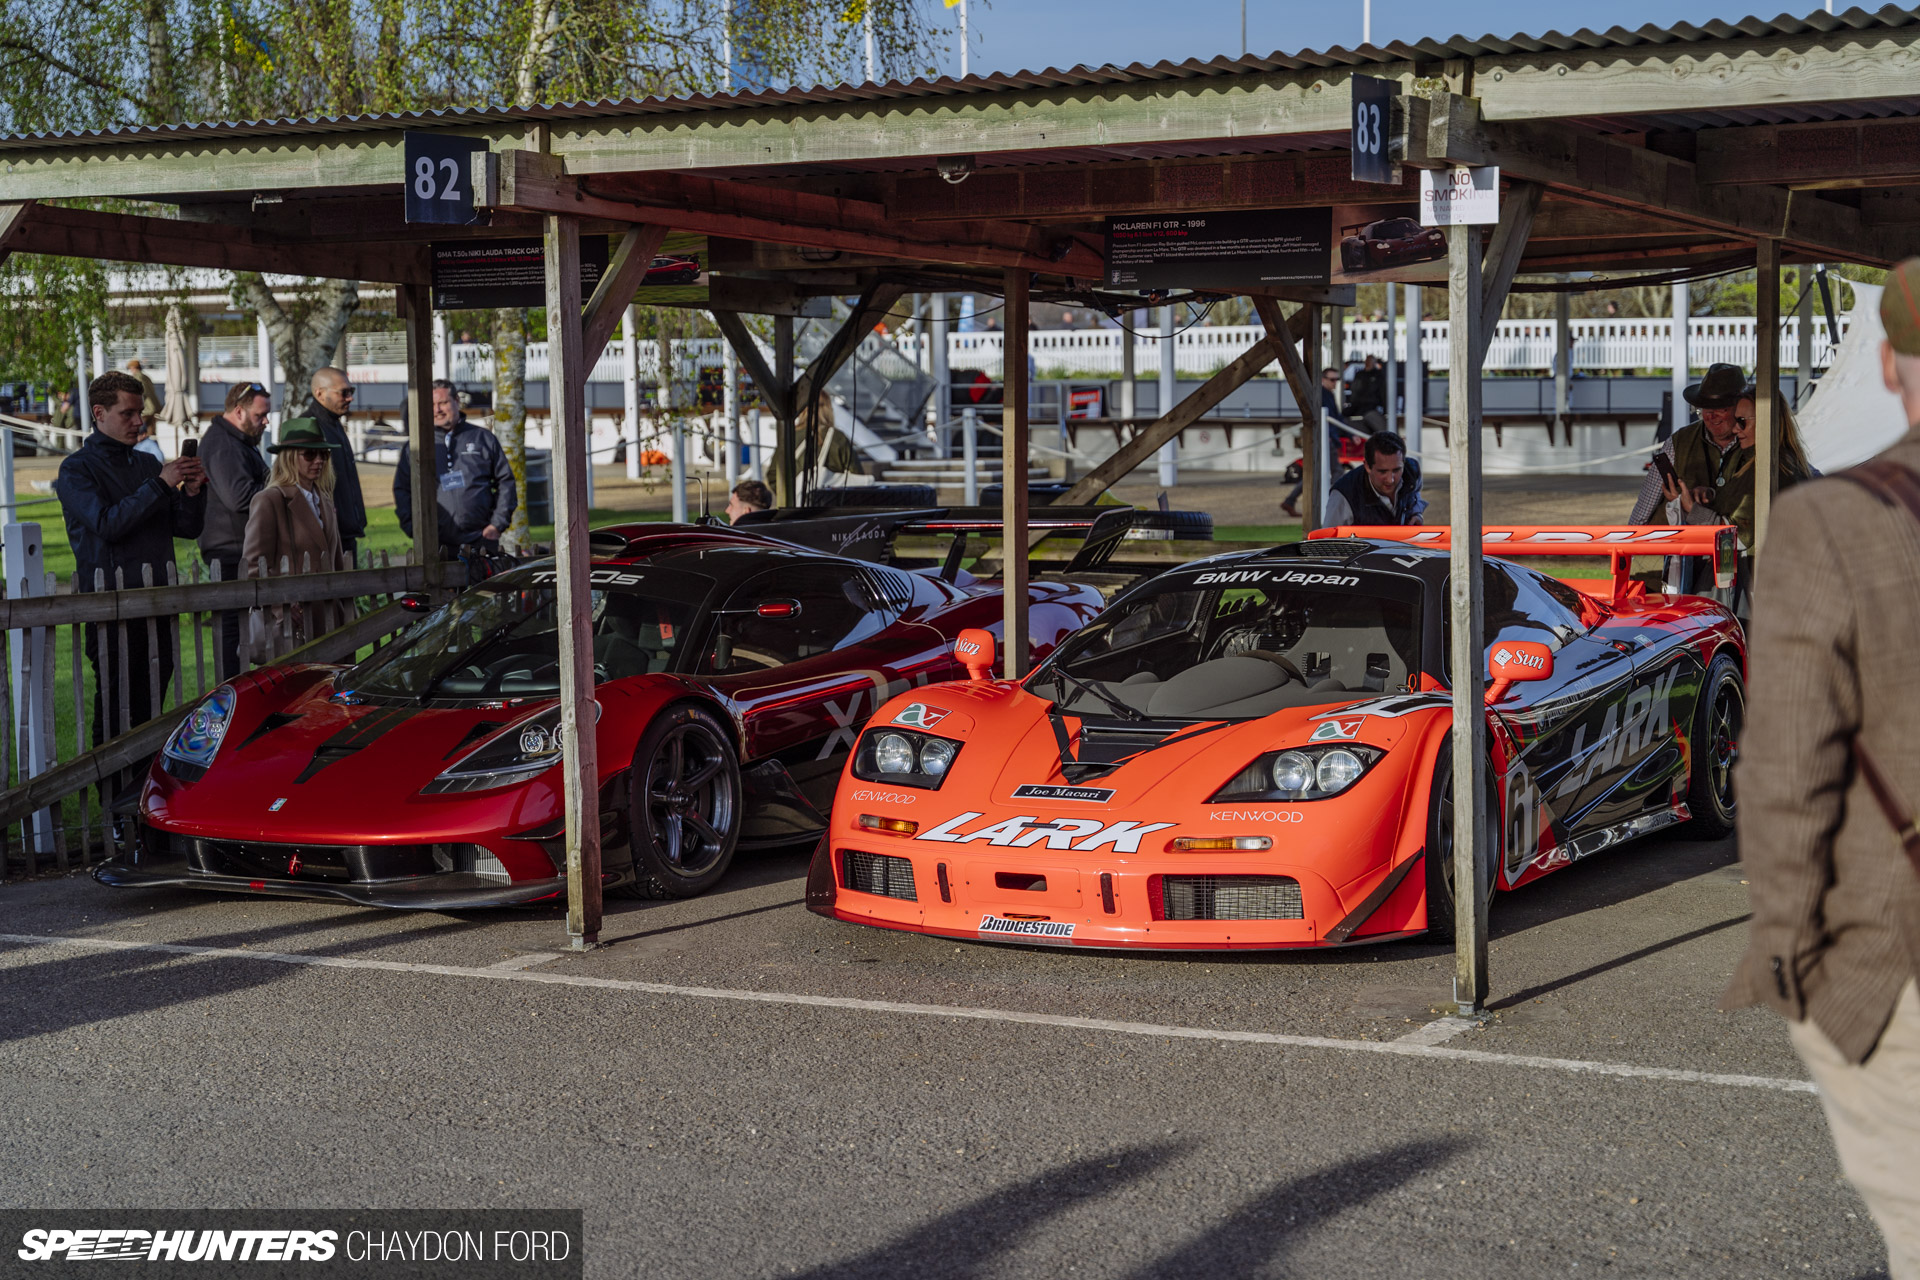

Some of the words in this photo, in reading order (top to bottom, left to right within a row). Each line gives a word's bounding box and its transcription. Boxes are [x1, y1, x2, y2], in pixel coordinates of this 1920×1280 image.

[1357, 102, 1381, 155] 83
[414, 156, 461, 201] 82
[1449, 173, 1471, 186] NO
[1424, 188, 1495, 202] SMOKING
[1113, 222, 1152, 230] MCLAREN
[1163, 220, 1180, 229] GTR
[1187, 219, 1206, 228] 1996
[481, 248, 503, 257] LAUDA
[503, 247, 525, 255] TRACK
[855, 529, 886, 542] LAUDA
[1192, 570, 1272, 585] BMW
[1271, 570, 1360, 587] Japan
[957, 637, 980, 655] Sun
[1513, 649, 1544, 669] Sun
[1556, 664, 1680, 799] LARK
[850, 789, 917, 805] KENWOOD
[1026, 787, 1049, 796] Joe
[1051, 787, 1101, 799] Macari
[1210, 810, 1304, 823] KENWOOD
[914, 811, 1181, 853] LARK
[980, 915, 1074, 936] BRIDGESTONE
